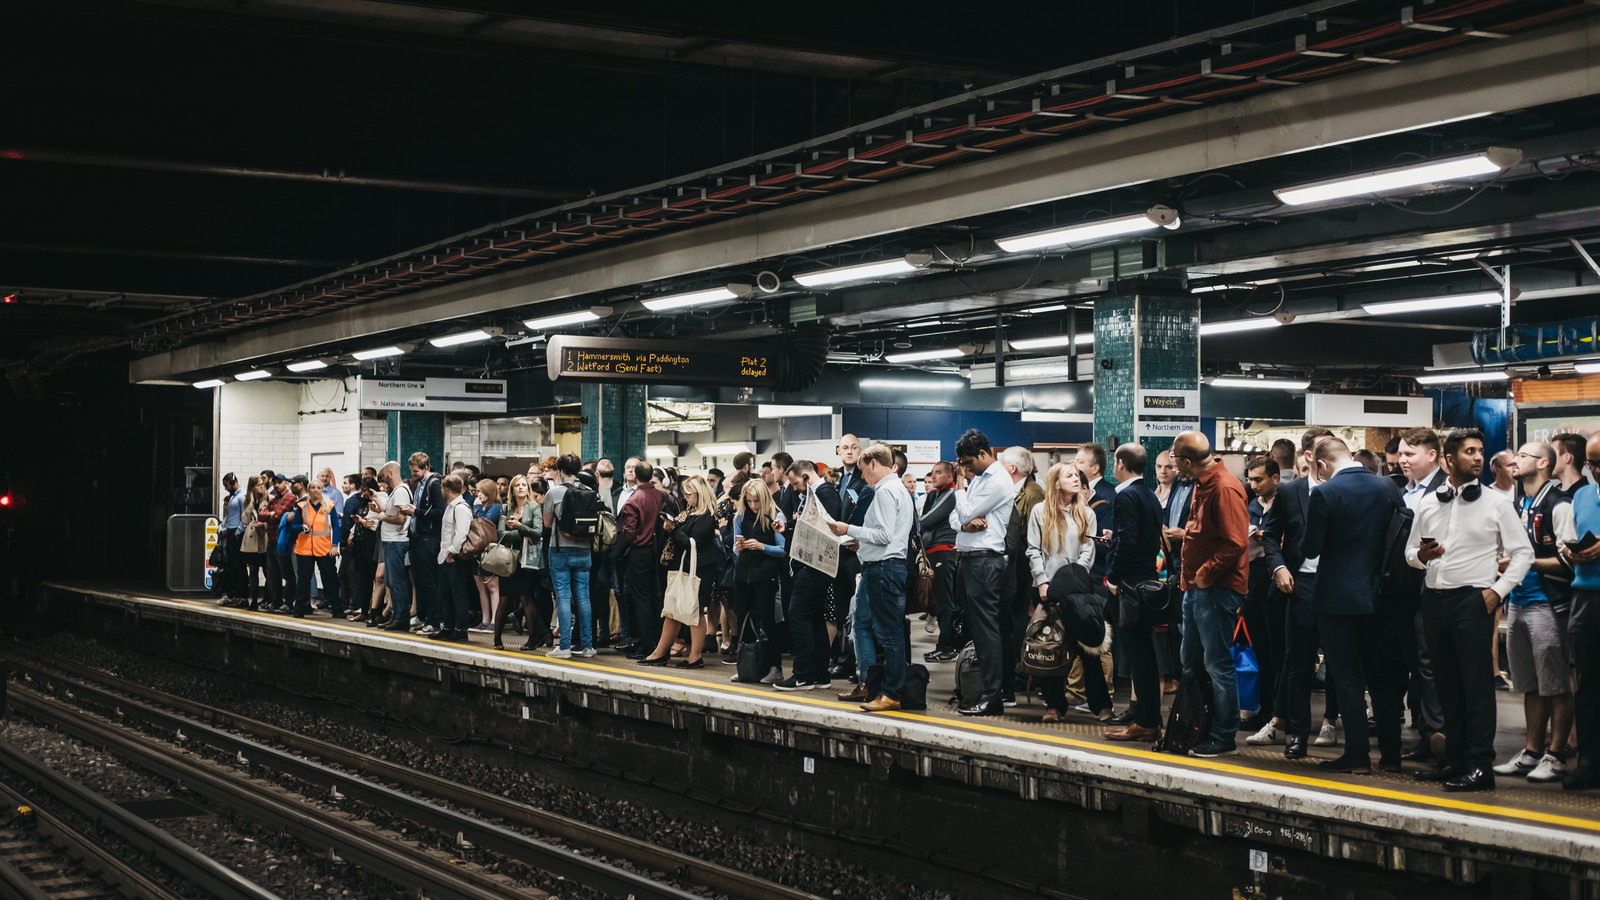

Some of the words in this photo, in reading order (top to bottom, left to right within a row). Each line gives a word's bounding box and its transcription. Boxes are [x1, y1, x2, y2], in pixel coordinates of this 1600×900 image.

[567, 351, 572, 361] 1
[577, 351, 631, 362] Hammersmith
[636, 353, 647, 362] via
[649, 353, 690, 366] Paddington
[741, 356, 758, 367] Plat
[760, 358, 767, 368] 2
[567, 361, 574, 372] 2
[577, 361, 610, 372] Watford
[615, 362, 638, 374] (Semi
[640, 363, 662, 374] Fast)
[741, 368, 767, 377] delayed
[378, 381, 406, 389] Northern
[1152, 398, 1165, 406] Way
[1028, 652, 1055, 661] animal
